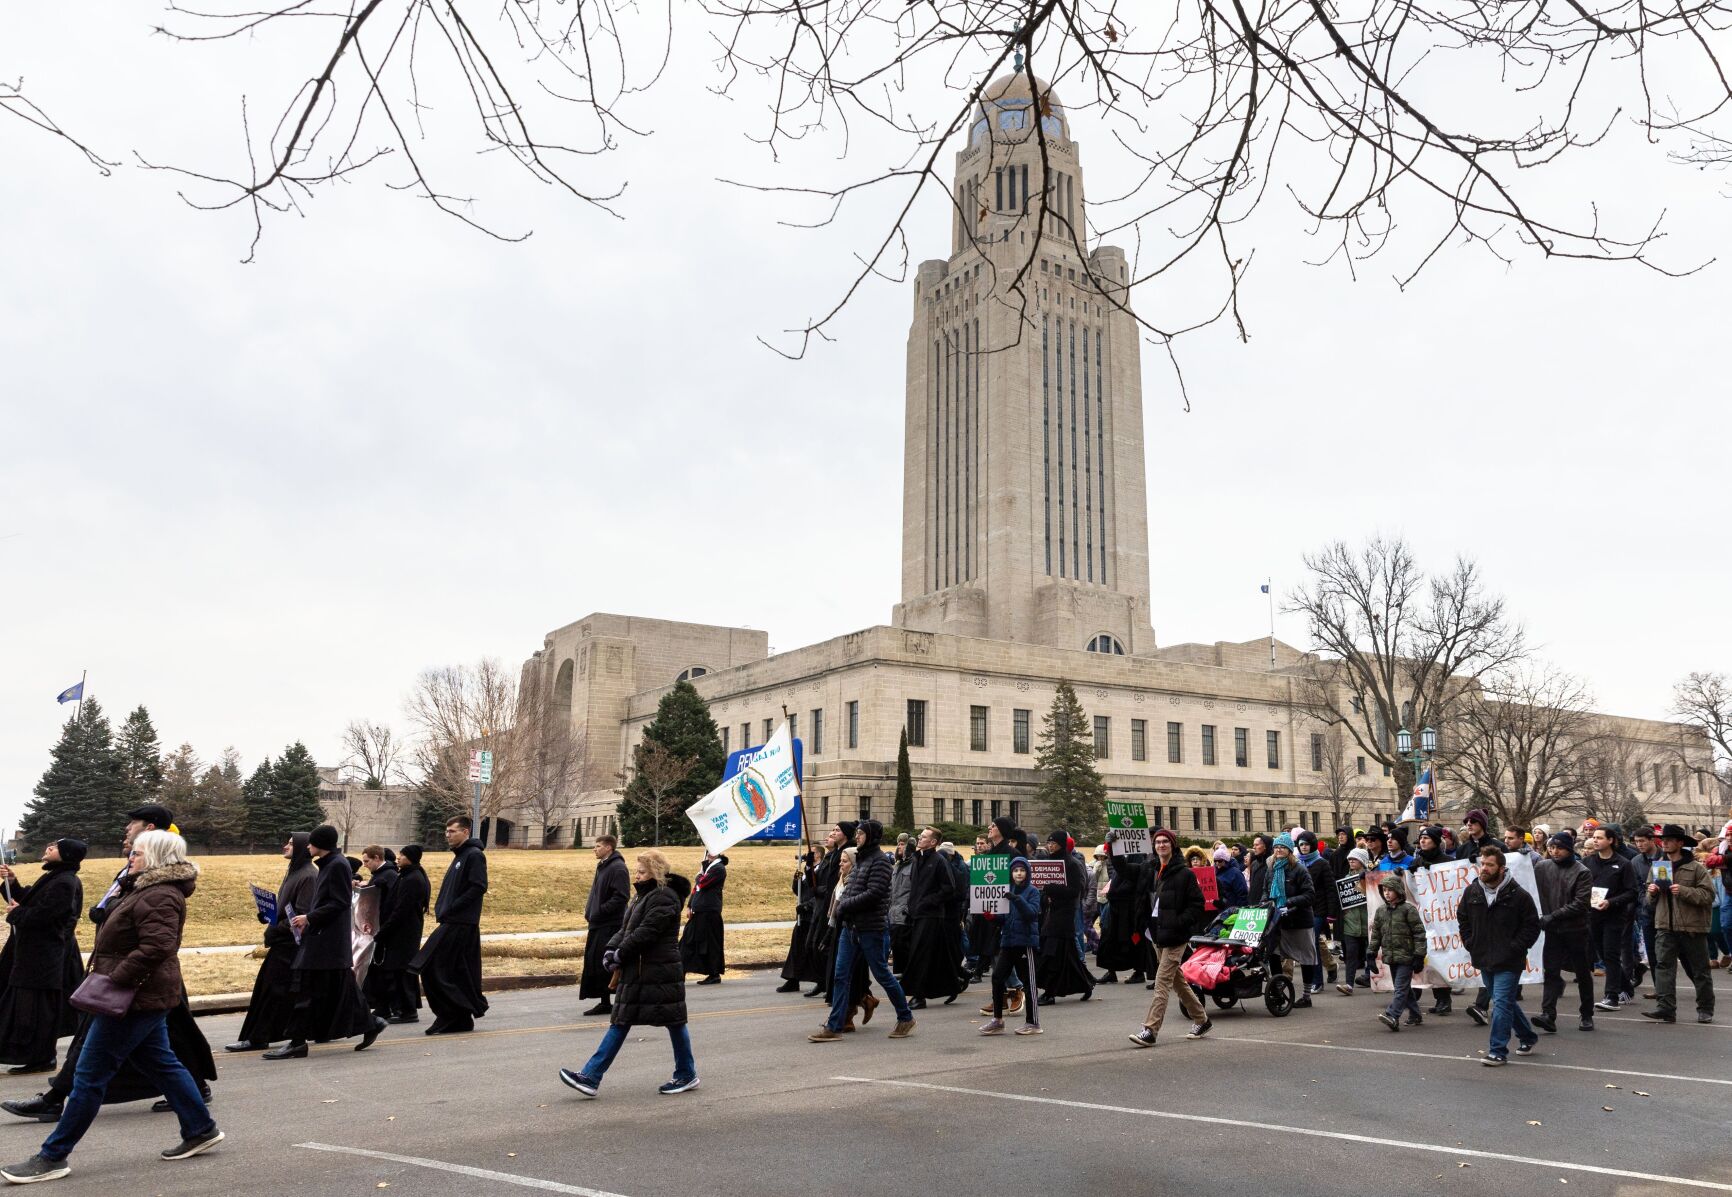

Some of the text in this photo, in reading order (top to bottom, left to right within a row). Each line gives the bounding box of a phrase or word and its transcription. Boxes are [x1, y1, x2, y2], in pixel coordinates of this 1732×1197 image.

[1107, 802, 1144, 816] LOVE LIFE
[1114, 829, 1146, 840] CHOOSE
[1123, 841, 1141, 854] LIFE
[972, 857, 1008, 871] LOVE LIFE
[975, 886, 1006, 899] CHOOSE
[982, 900, 998, 913] LIFE
[1239, 909, 1268, 920] LOVE LIFE
[1234, 930, 1262, 942] CHOOSE
